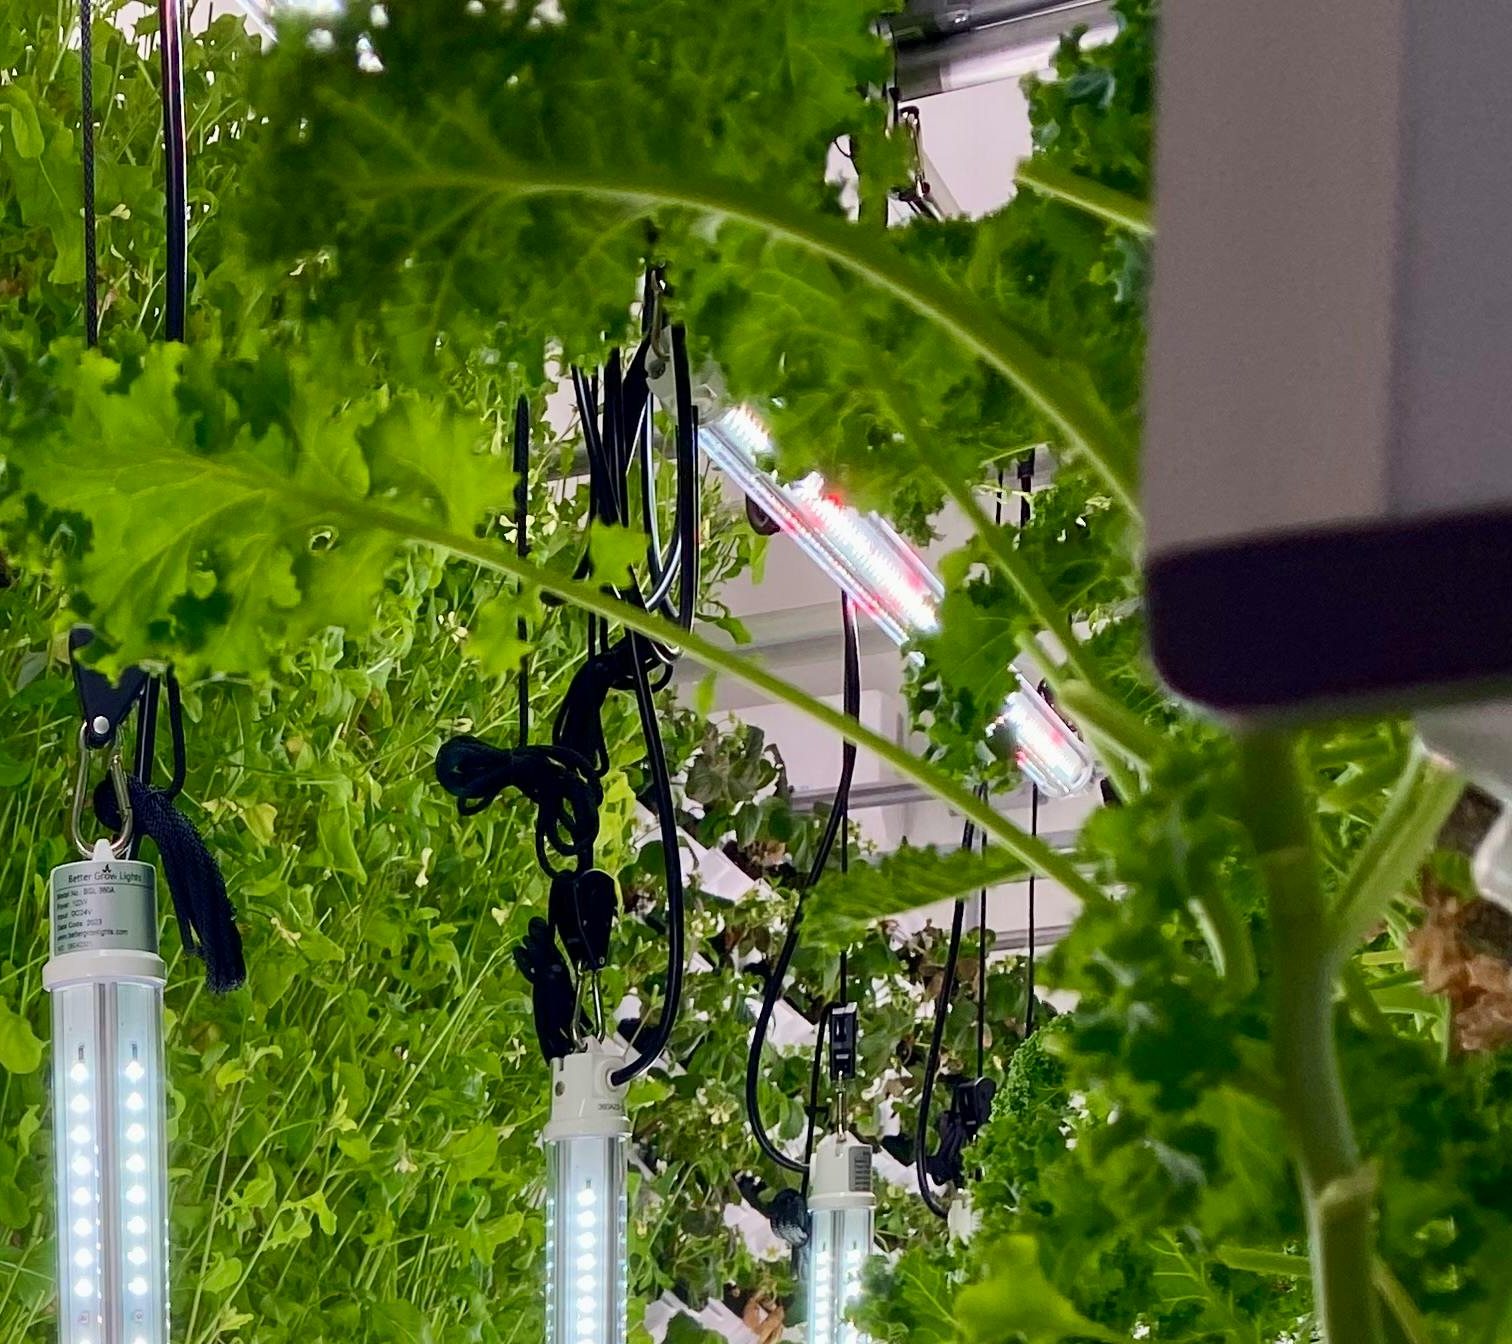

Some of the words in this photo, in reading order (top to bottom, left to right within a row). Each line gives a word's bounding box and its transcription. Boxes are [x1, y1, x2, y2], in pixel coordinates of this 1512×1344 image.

[68, 874, 91, 883] Better
[94, 871, 117, 881] Grow
[119, 871, 142, 883] Lights
